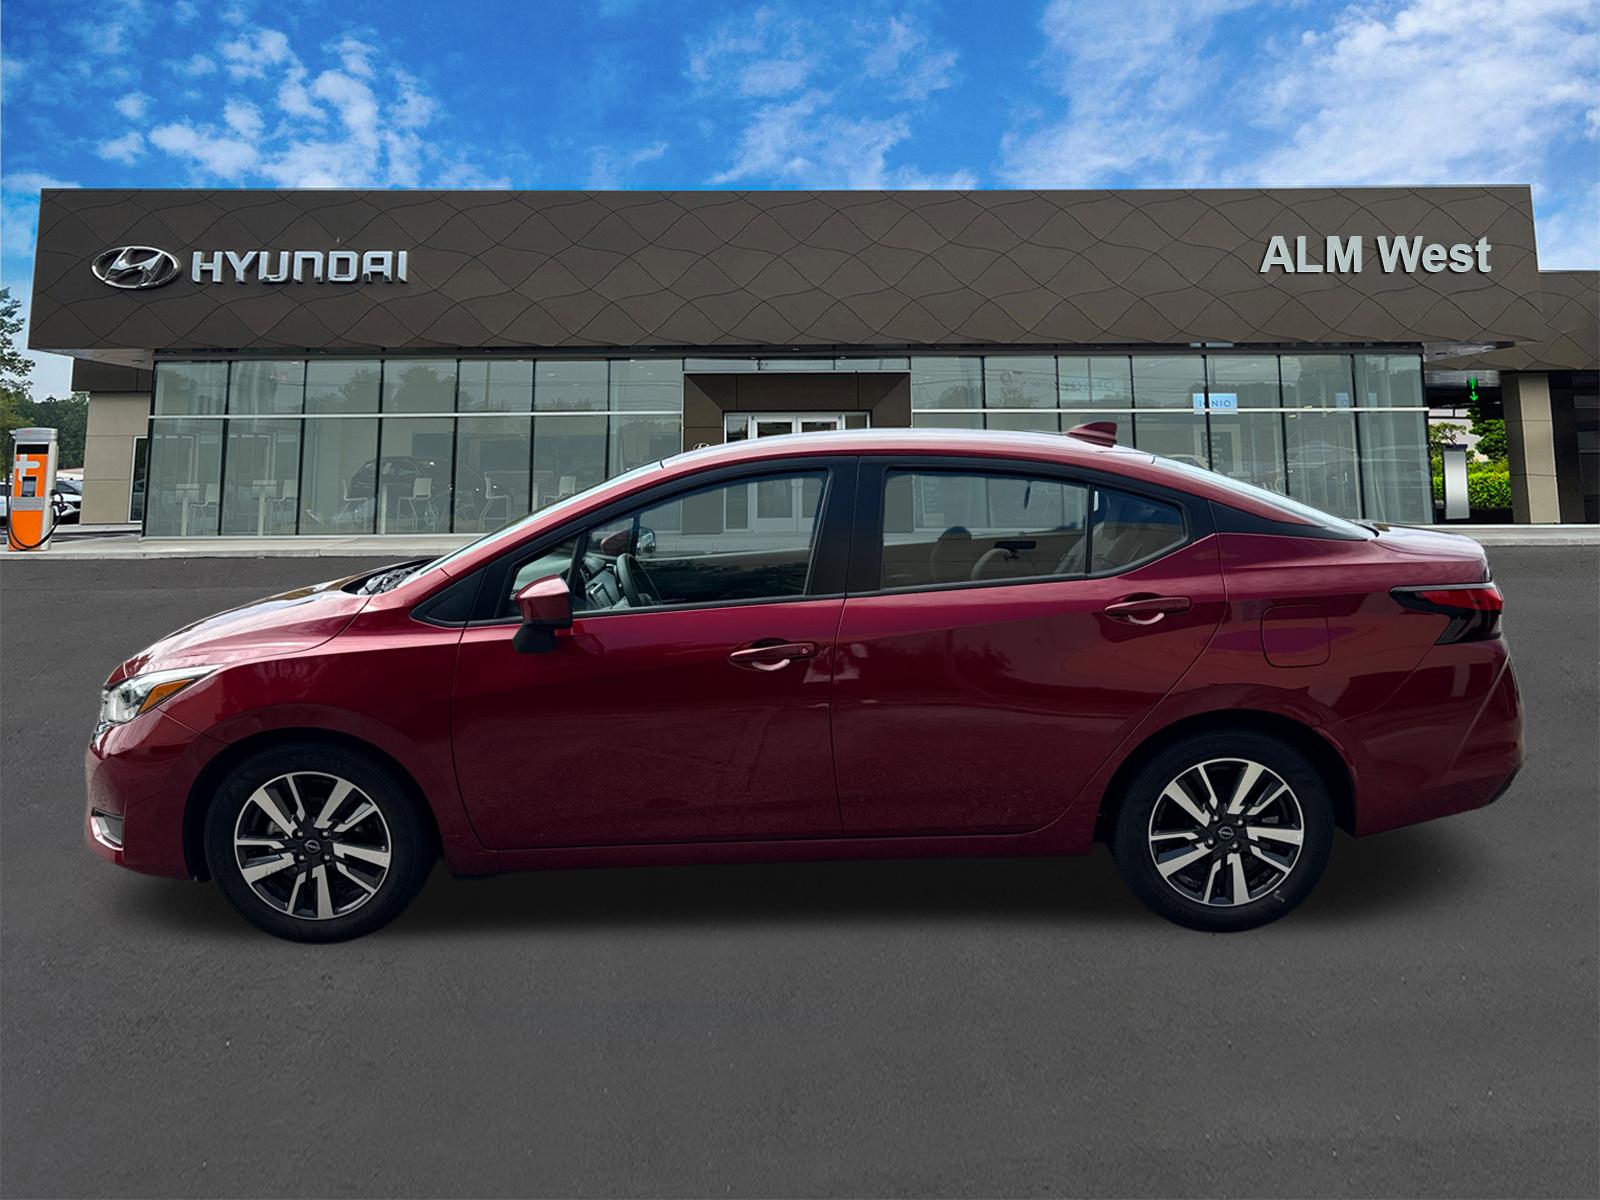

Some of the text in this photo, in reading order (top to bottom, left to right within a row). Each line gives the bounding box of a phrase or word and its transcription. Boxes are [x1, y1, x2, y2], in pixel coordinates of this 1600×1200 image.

[191, 251, 408, 283] HYUNDAI
[1259, 235, 1492, 273] ALM West
